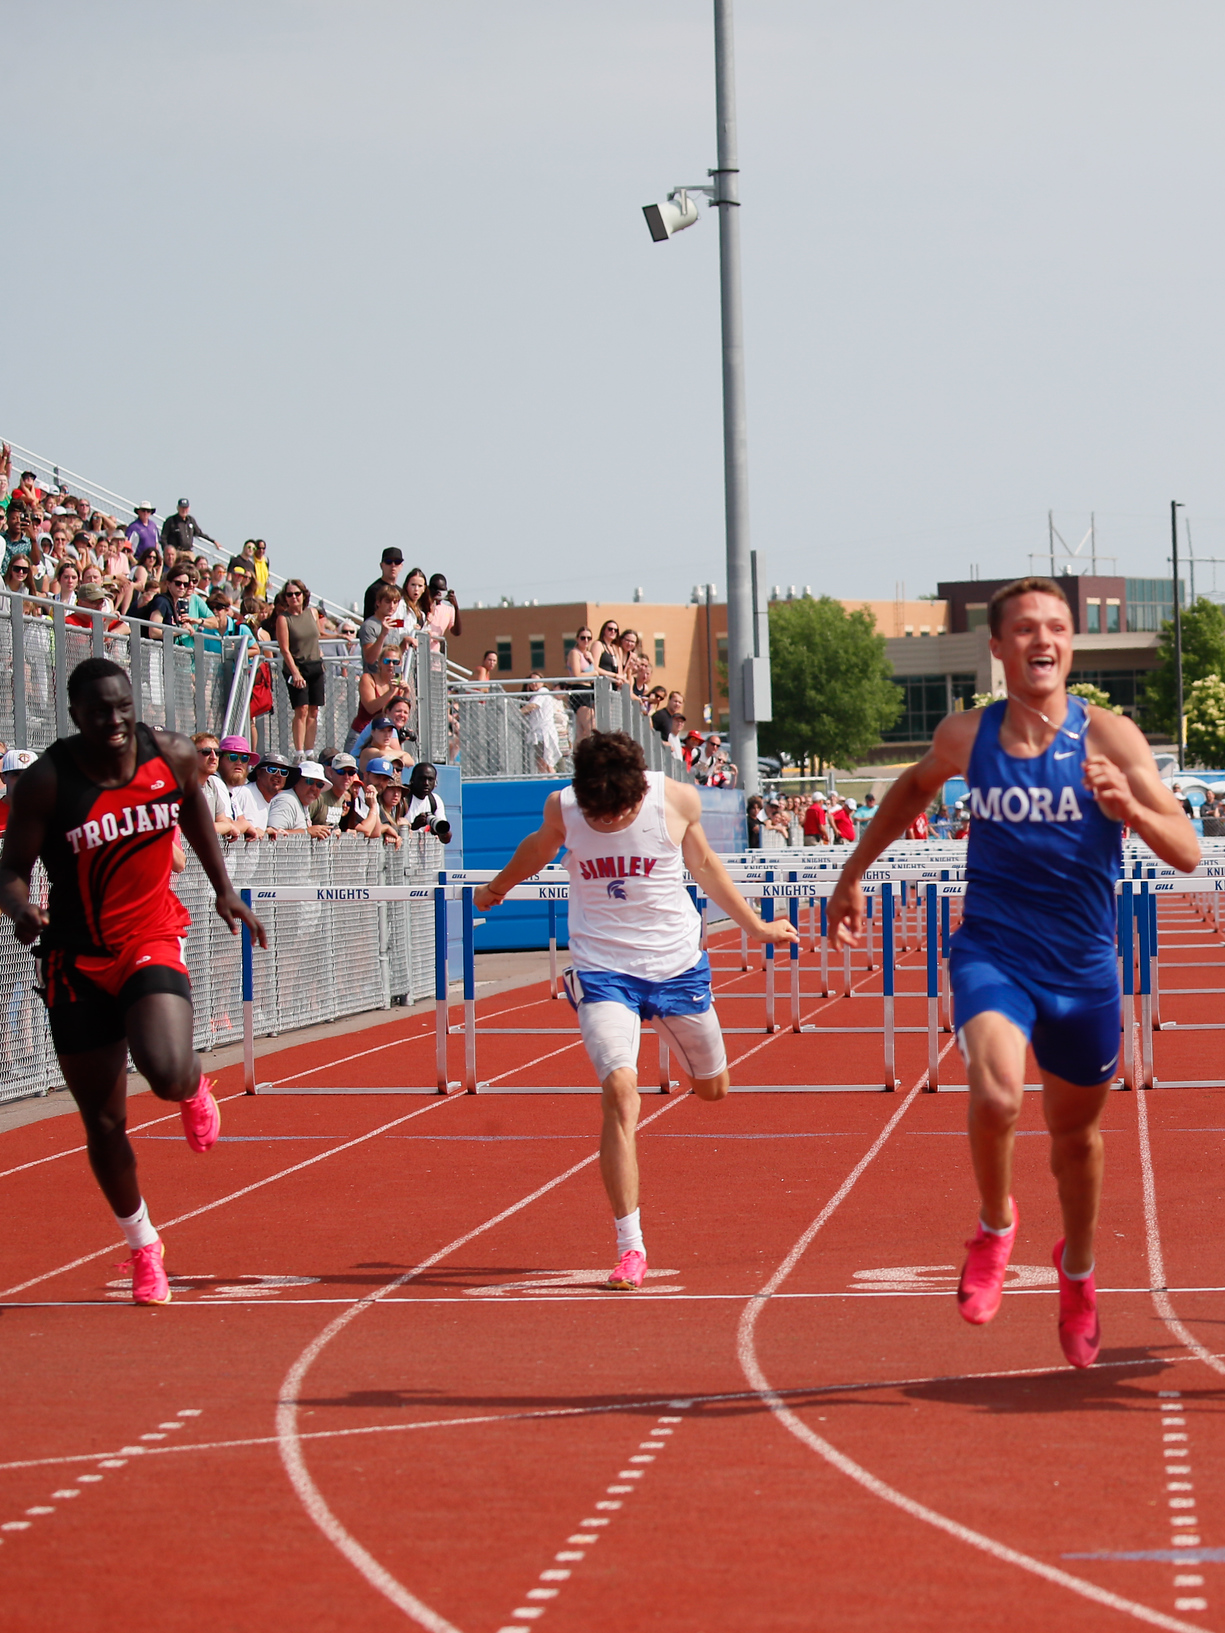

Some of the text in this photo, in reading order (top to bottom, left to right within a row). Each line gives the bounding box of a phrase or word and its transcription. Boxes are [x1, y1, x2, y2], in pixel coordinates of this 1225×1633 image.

[970, 786, 1083, 823] MORA
[65, 803, 180, 854] TROJANS
[579, 856, 658, 880] SIMLEY
[863, 871, 891, 880] IGHTS
[317, 888, 370, 900] KNIGHTS
[539, 887, 568, 899] KNIG
[763, 884, 816, 896] KNIGHTS
